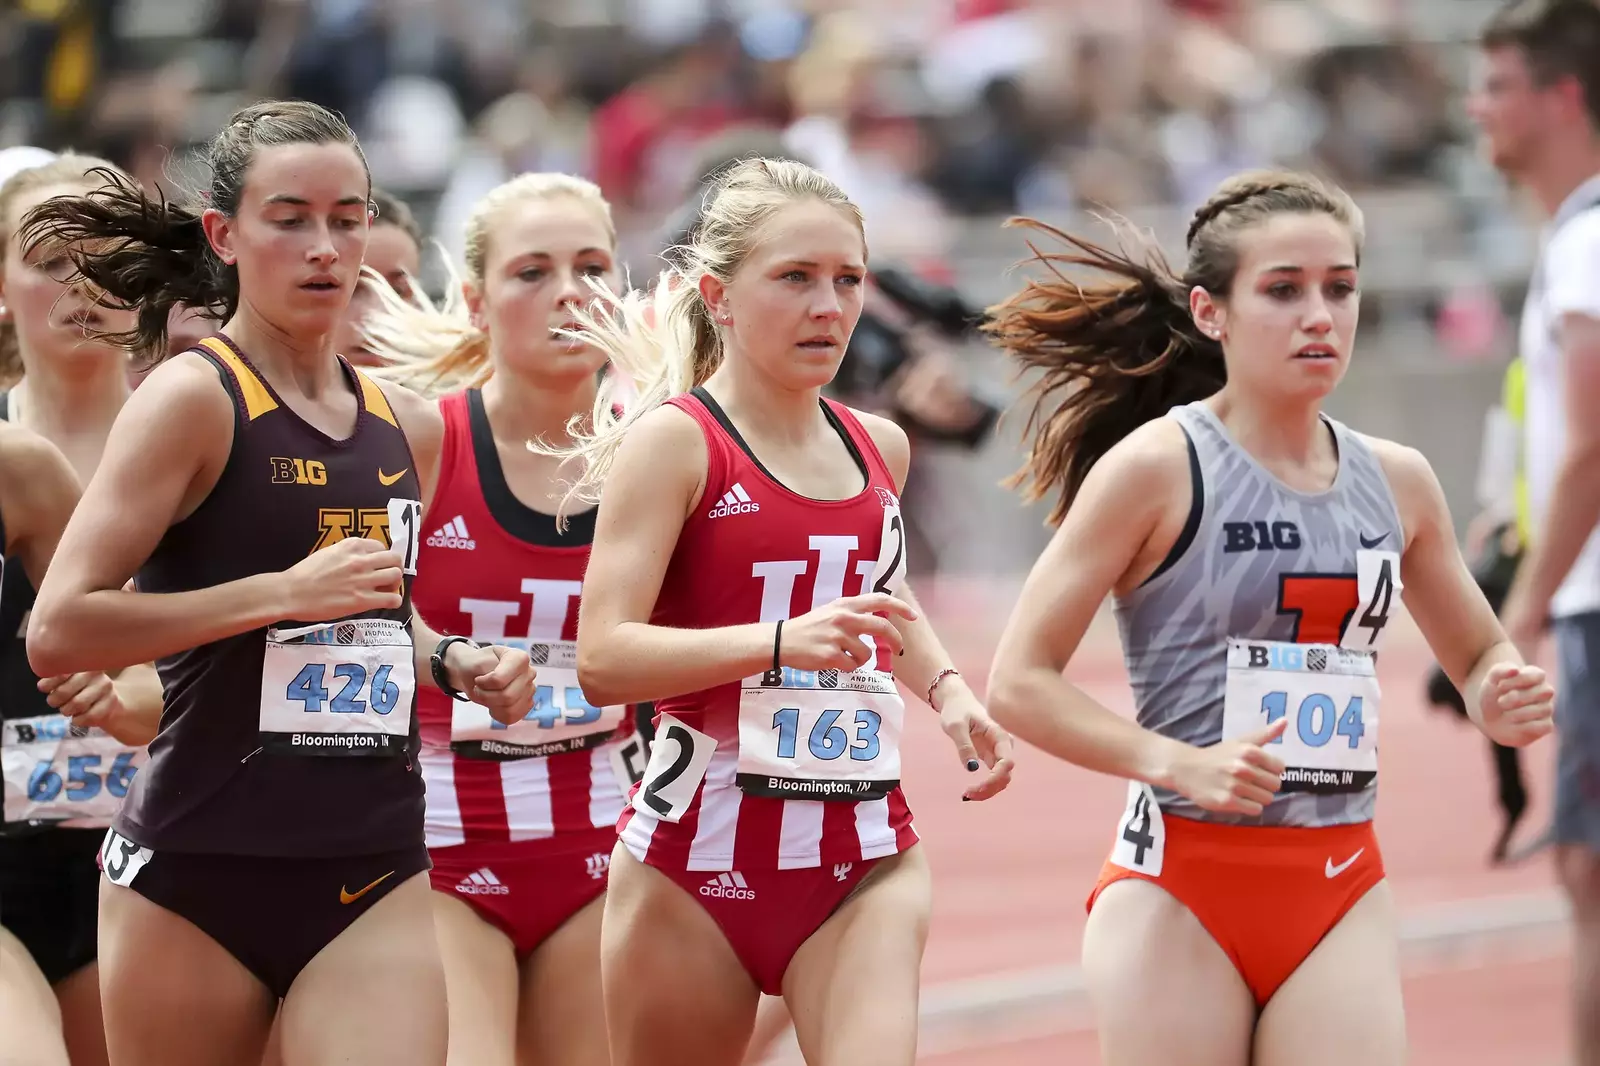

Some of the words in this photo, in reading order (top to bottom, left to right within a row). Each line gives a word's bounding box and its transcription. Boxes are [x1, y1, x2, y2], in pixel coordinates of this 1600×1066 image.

[708, 501, 760, 519] adidas
[426, 536, 476, 550] adidas
[873, 515, 903, 595] 2
[1358, 559, 1393, 645] 4
[286, 663, 400, 715] 426
[772, 708, 882, 762] 163
[1261, 691, 1365, 749] 104
[291, 733, 378, 748] Bloomington,
[381, 734, 390, 747] IN
[481, 740, 567, 756] Bloomington,
[570, 738, 585, 750] IN
[27, 752, 139, 803] 656
[643, 725, 695, 818] 2
[768, 777, 853, 795] Bloomington,
[857, 782, 871, 792] IN
[1342, 773, 1353, 784] IN
[1123, 790, 1154, 866] 4
[455, 884, 509, 895] adidas
[699, 884, 756, 900] adidas
